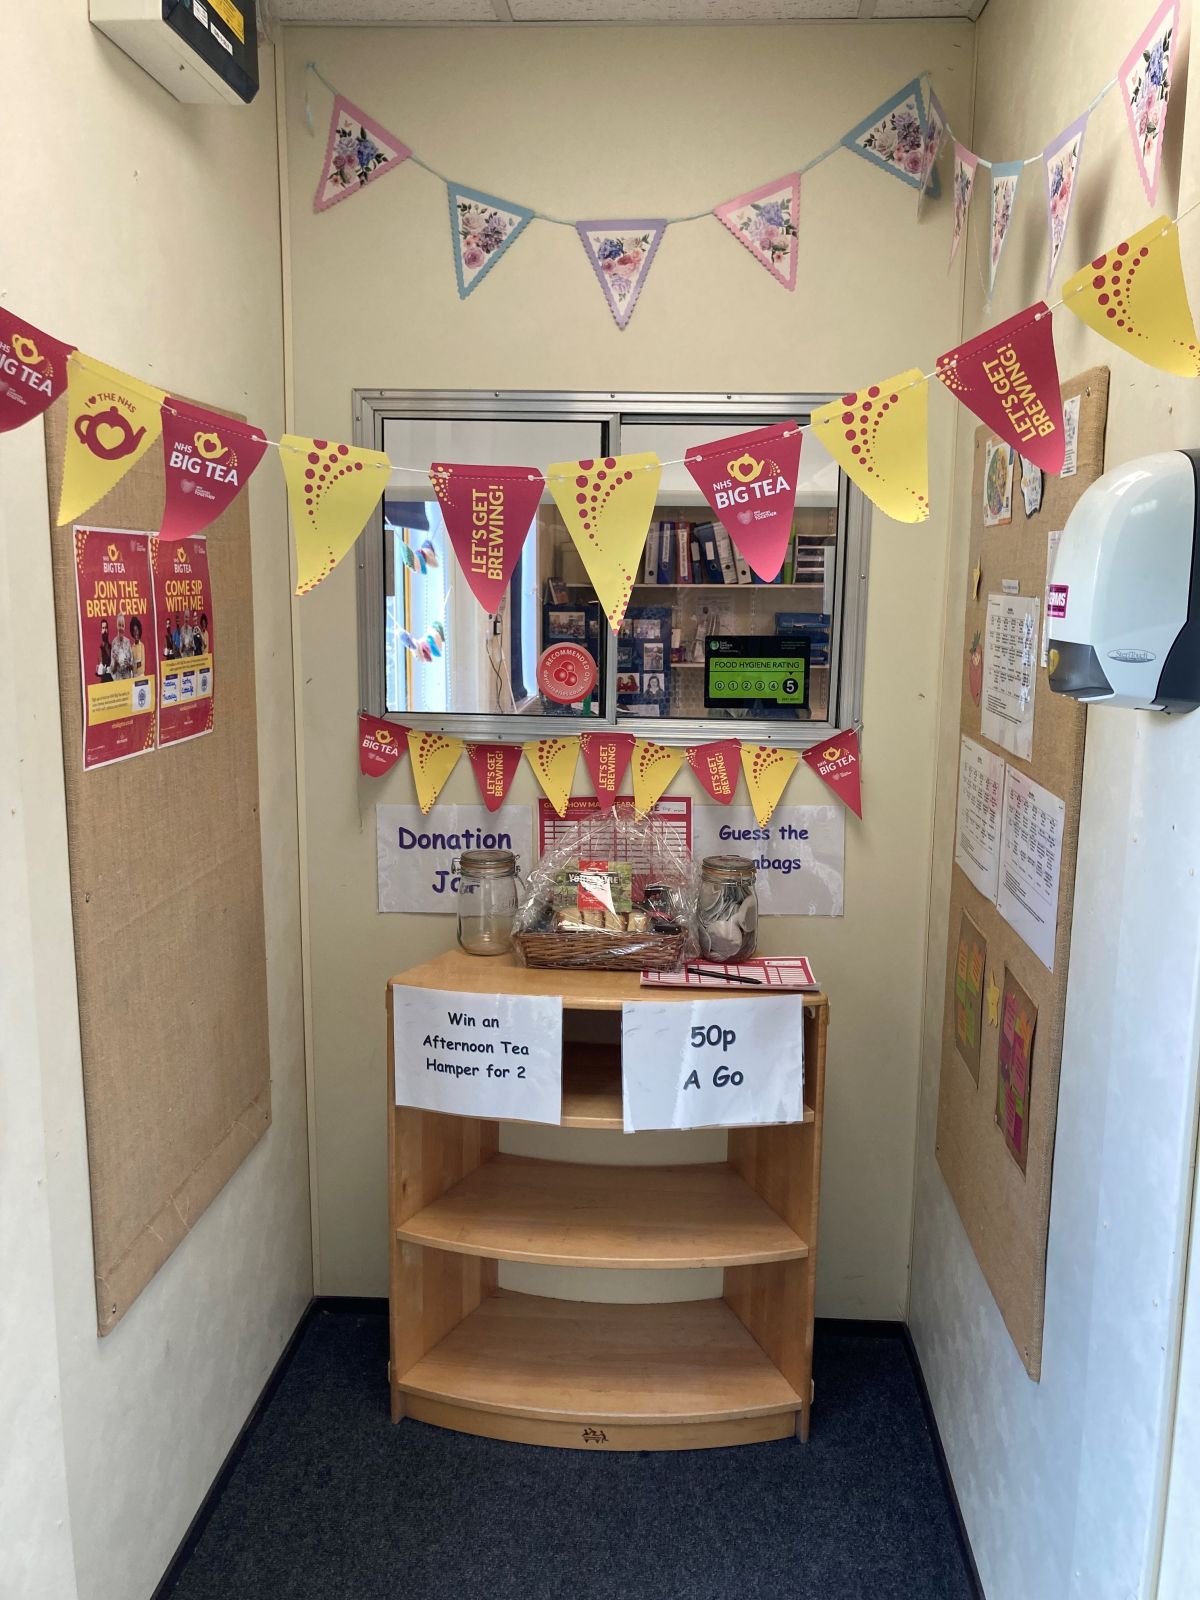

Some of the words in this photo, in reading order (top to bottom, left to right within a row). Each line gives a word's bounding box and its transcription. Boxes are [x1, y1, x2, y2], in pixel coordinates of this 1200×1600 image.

[0, 341, 10, 353] HS
[0, 353, 19, 375] IG
[21, 365, 53, 397] TEA
[982, 359, 1010, 394] GET
[997, 343, 1055, 437] BREWING!
[97, 392, 116, 402] THE
[117, 396, 136, 413] NHS
[1002, 394, 1037, 442] LET'S
[174, 442, 192, 453] NHS
[169, 451, 202, 474] BIG
[205, 461, 238, 486] TEA
[713, 480, 732, 491] NHS
[715, 487, 749, 509] BIG
[750, 476, 790, 499] TEA
[472, 488, 488, 526] GET
[488, 485, 504, 580] BREWING!
[471, 529, 487, 574] LET'S
[94, 581, 118, 598] JOIN
[119, 580, 139, 598] THE
[165, 580, 190, 596] COME
[191, 580, 203, 595] SIP
[86, 600, 116, 618] BREW
[119, 598, 147, 616] CREW
[165, 596, 189, 612] WITH
[190, 596, 204, 611] ME!
[545, 649, 590, 670] RECOMMENDED
[714, 661, 737, 669] FOOD
[740, 661, 771, 669] HYGIENE
[773, 661, 800, 669] RATING
[786, 680, 795, 692] 5
[362, 739, 380, 751] BIG
[380, 744, 398, 757] TEA
[600, 745, 608, 763] GET
[487, 752, 495, 770] GET
[607, 743, 616, 791] BREWING!
[707, 756, 718, 774] GET
[819, 763, 837, 776] BIG
[836, 754, 856, 768] TEA
[486, 771, 495, 794] LET'S
[495, 750, 504, 797] BREWING!
[599, 765, 607, 788] LET'S
[715, 752, 731, 795] BREWING!
[711, 774, 722, 795] LET'S
[398, 826, 512, 850] Donation
[719, 825, 770, 840] Guess
[779, 825, 809, 840] the
[752, 855, 801, 874] abags
[448, 1011, 476, 1027] Win
[482, 1017, 500, 1028] an
[423, 1034, 494, 1054] Afternoon
[500, 1041, 530, 1056] Tea
[691, 1024, 736, 1052] 50p
[426, 1058, 480, 1079] Hamper
[486, 1063, 510, 1079] for
[517, 1066, 526, 1079] 2
[683, 1069, 701, 1091] A
[712, 1066, 744, 1088] Go
